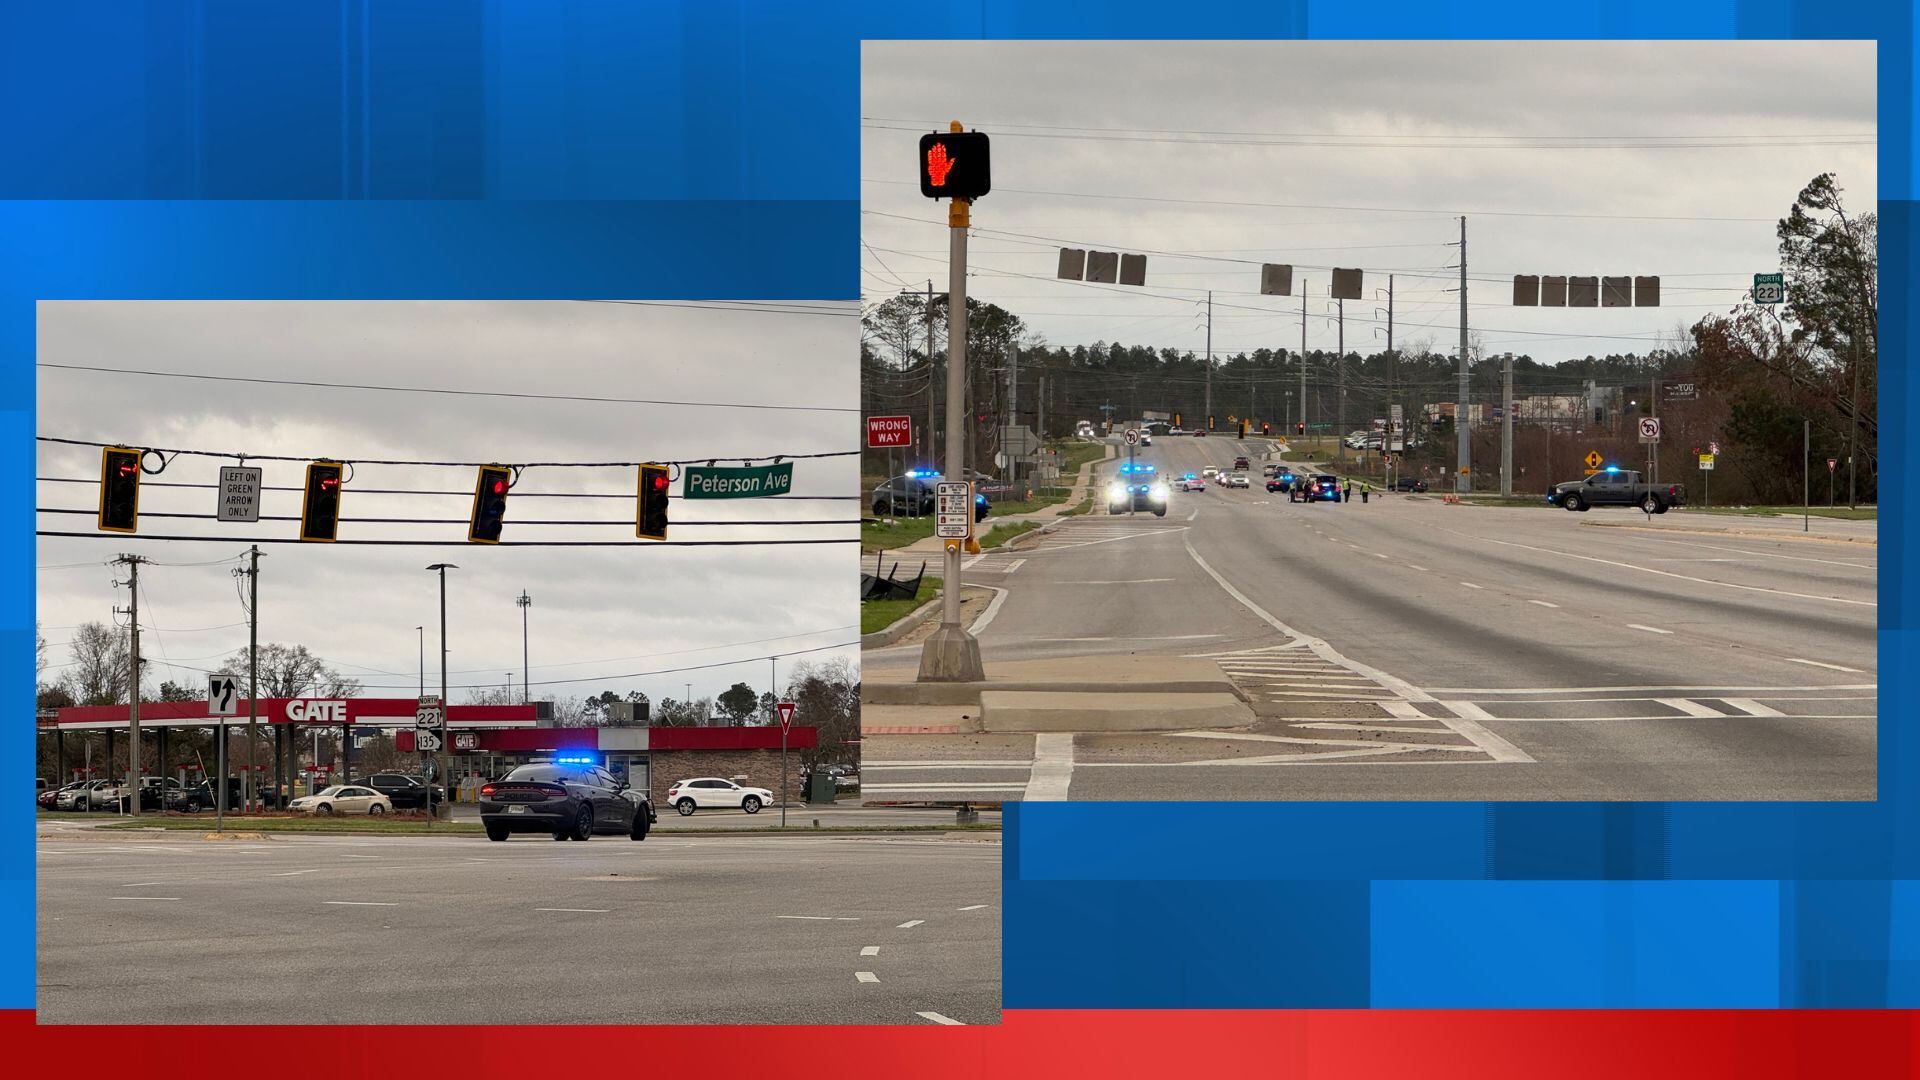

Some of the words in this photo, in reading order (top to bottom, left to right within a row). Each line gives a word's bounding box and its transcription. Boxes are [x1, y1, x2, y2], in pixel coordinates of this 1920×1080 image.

[1757, 275, 1780, 283] NORTH
[1758, 287, 1780, 298] 221
[870, 420, 908, 431] WRONG
[877, 432, 900, 443] WAY
[225, 472, 244, 481] LEFT
[245, 472, 257, 481] ON
[690, 474, 760, 493] Peterson
[763, 472, 789, 490] Ave
[227, 484, 253, 493] GREEN
[225, 496, 252, 505] ARROW
[228, 507, 249, 517] ONLY
[419, 697, 439, 705] NORTH
[285, 699, 347, 721] GATE
[418, 712, 440, 724] 221
[419, 735, 435, 748] 135
[455, 734, 474, 747] GATE
